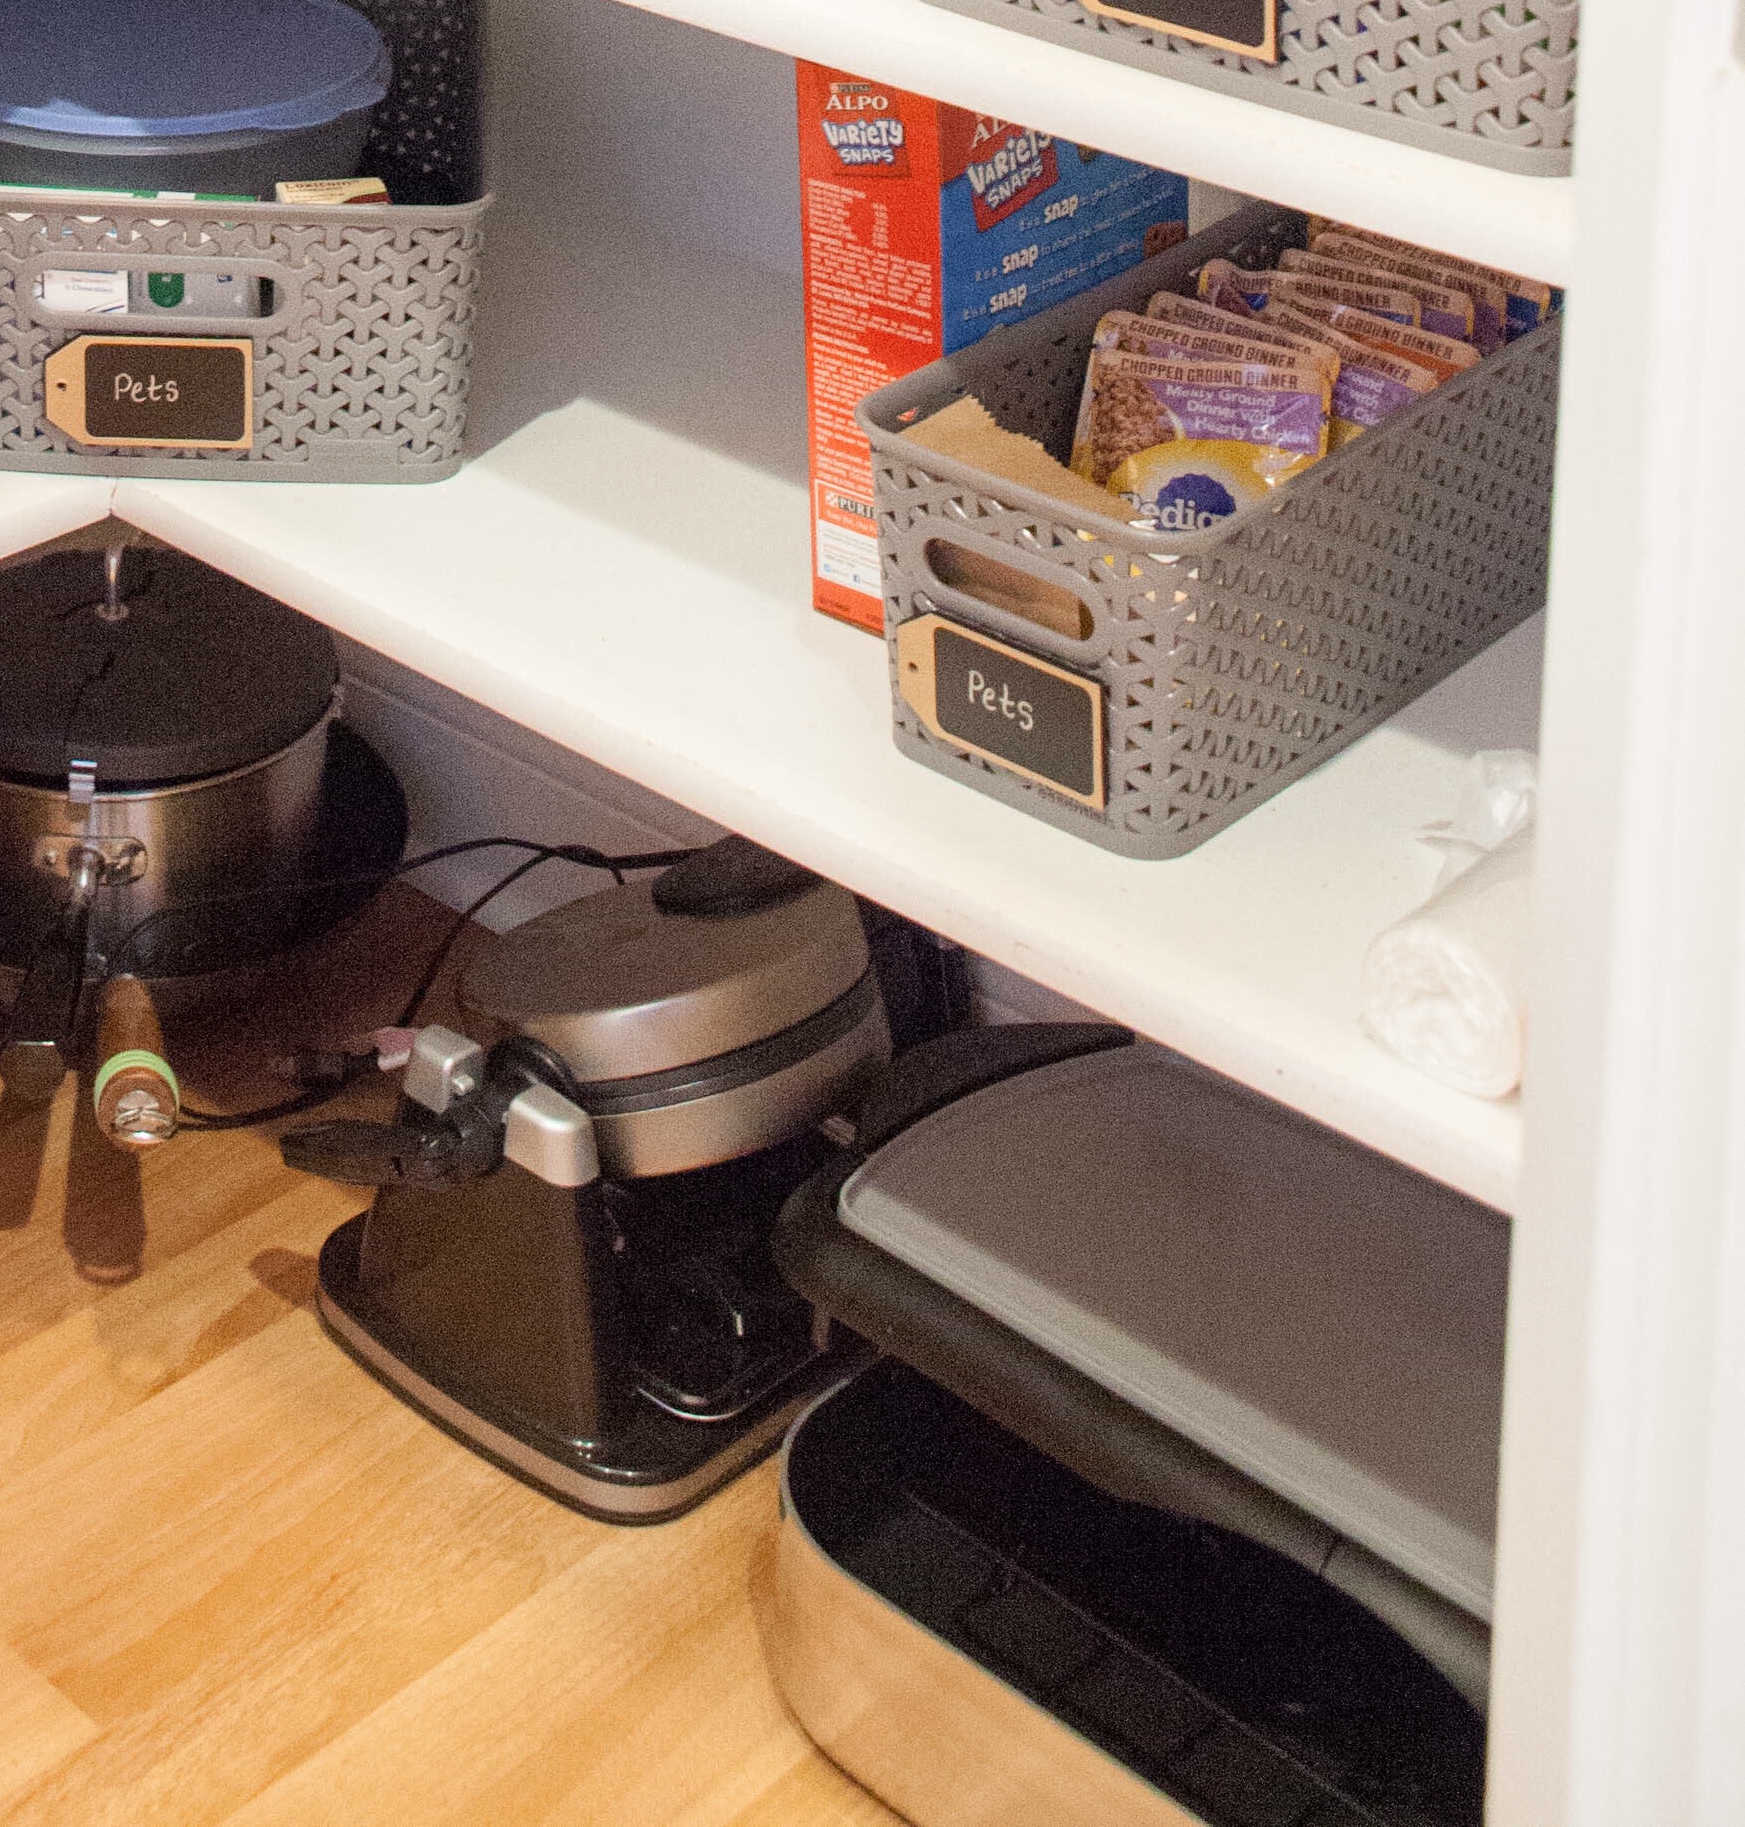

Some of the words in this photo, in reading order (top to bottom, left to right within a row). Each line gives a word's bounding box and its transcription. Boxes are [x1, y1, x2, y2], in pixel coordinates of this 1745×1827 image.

[826, 94, 889, 111] ALPO
[841, 147, 896, 166] SNAPS
[987, 159, 1045, 209] SNAPS
[1044, 193, 1080, 225] snap
[1002, 243, 1040, 275] snap
[990, 282, 1028, 313] snap
[1129, 319, 1189, 344] CHOPPED
[1190, 332, 1242, 355] GROUND
[1244, 345, 1297, 369] DINNER
[1397, 330, 1454, 361] DINNER
[114, 372, 180, 404] Pets
[1122, 358, 1183, 382] CHOPPED
[1187, 365, 1243, 385] GROUND
[1244, 369, 1300, 389] DINNER
[1166, 383, 1218, 404] Meaty
[1219, 387, 1277, 408] Ground
[1186, 401, 1238, 422] Dinner
[1194, 415, 1249, 440] Hearty
[968, 671, 1035, 732] Pets
